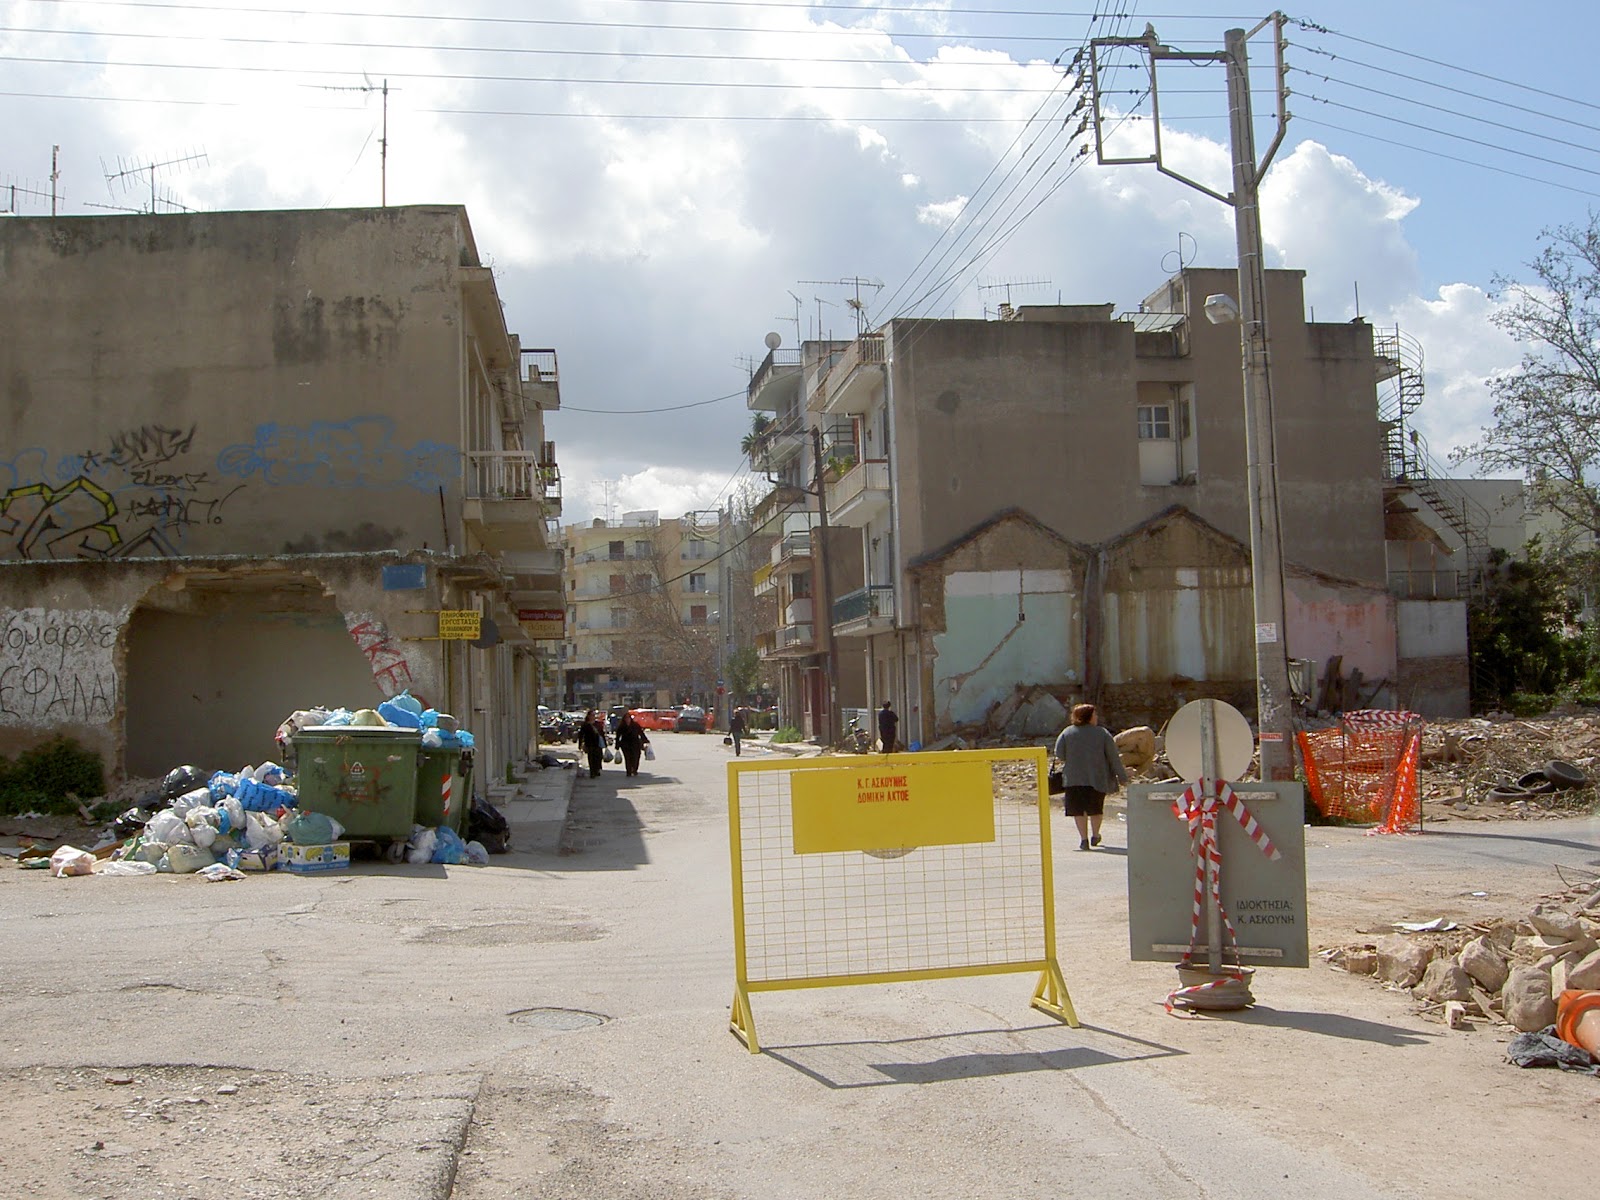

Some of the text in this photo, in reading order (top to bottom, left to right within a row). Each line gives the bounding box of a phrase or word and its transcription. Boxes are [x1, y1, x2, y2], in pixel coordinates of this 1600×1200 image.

[872, 776, 907, 788] ΑΣΚΟΥΝΗΣ
[858, 792, 884, 803] ΔΟΜΙΚΗ
[1236, 900, 1293, 910] ΙΔΙΟΚΤΗΣΙΑ:
[1237, 914, 1295, 925] Κ. ΑΣΚΟΥΝΗ
